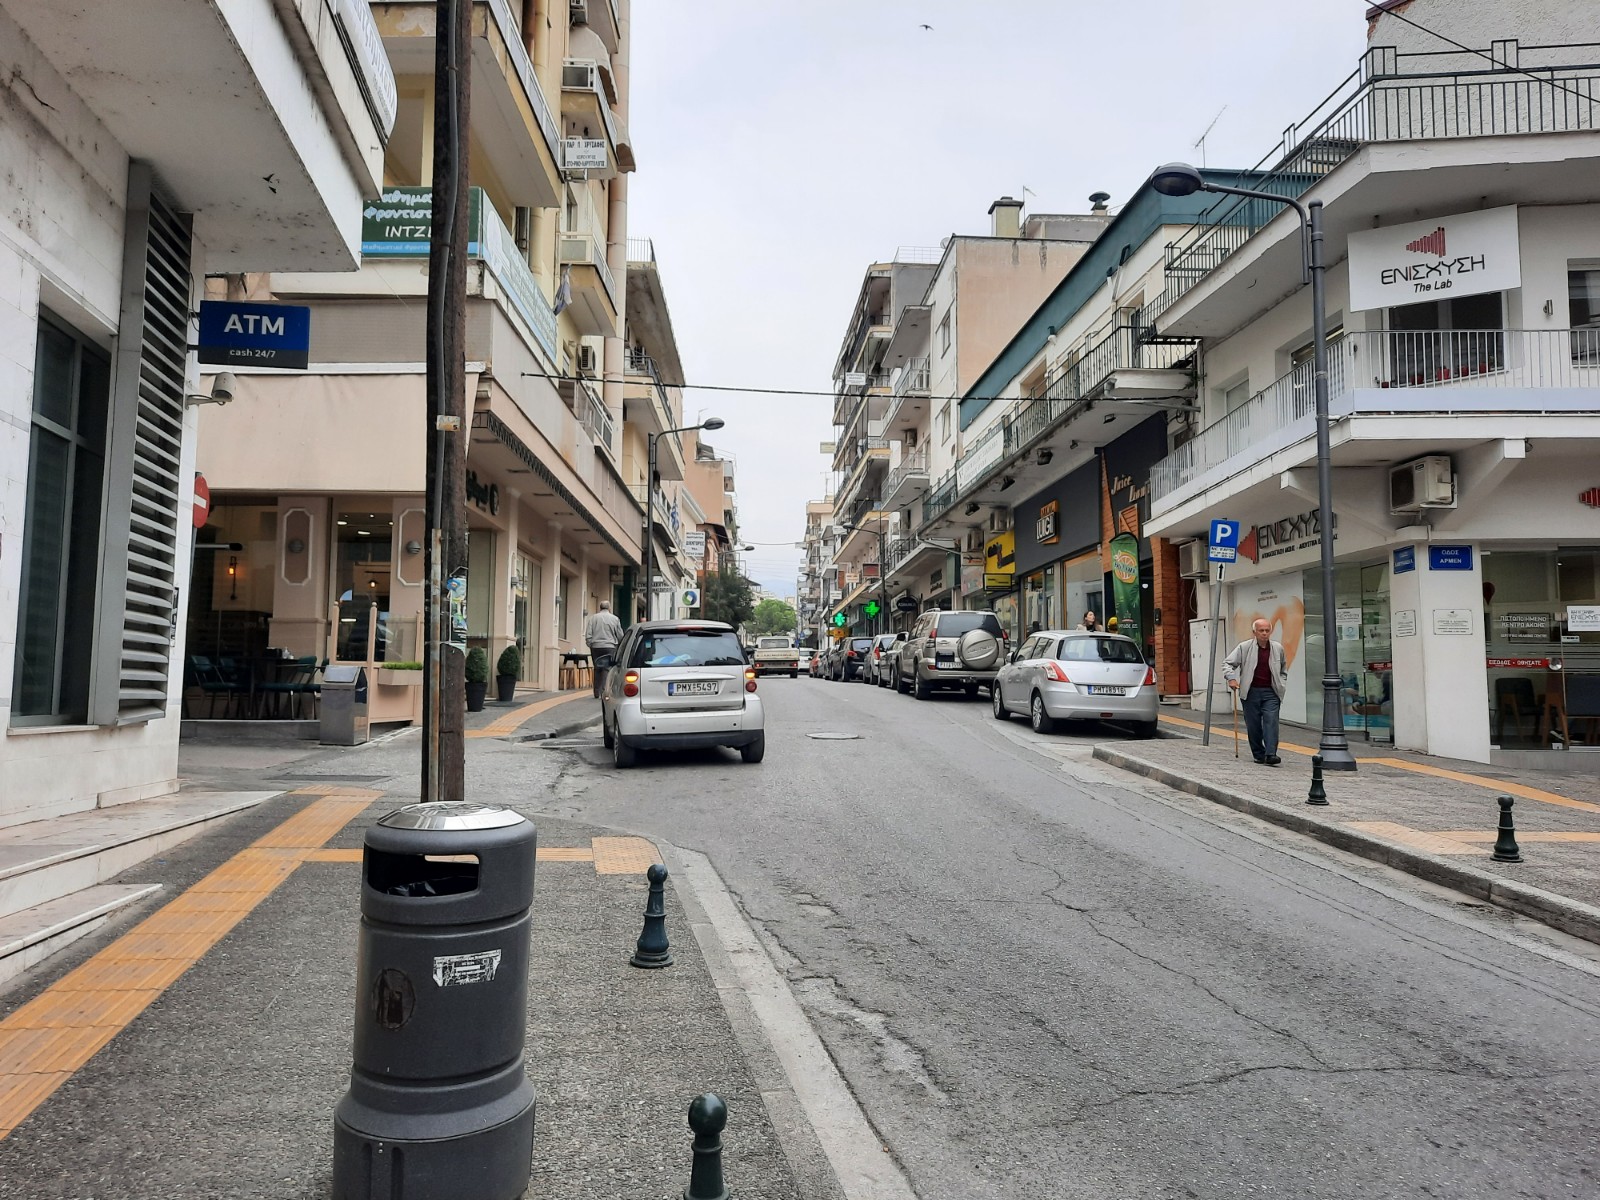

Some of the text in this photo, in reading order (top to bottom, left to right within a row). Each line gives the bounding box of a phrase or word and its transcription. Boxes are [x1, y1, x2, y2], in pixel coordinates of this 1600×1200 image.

[1381, 254, 1485, 285] ΕΝΙΣΧΥΣΗ
[1414, 279, 1452, 293] The Lab
[224, 314, 284, 336] ATM
[230, 348, 276, 358] cash 24/7
[1216, 524, 1232, 544] P
[1259, 507, 1337, 550] ΕΝΙΣΧΥΣ
